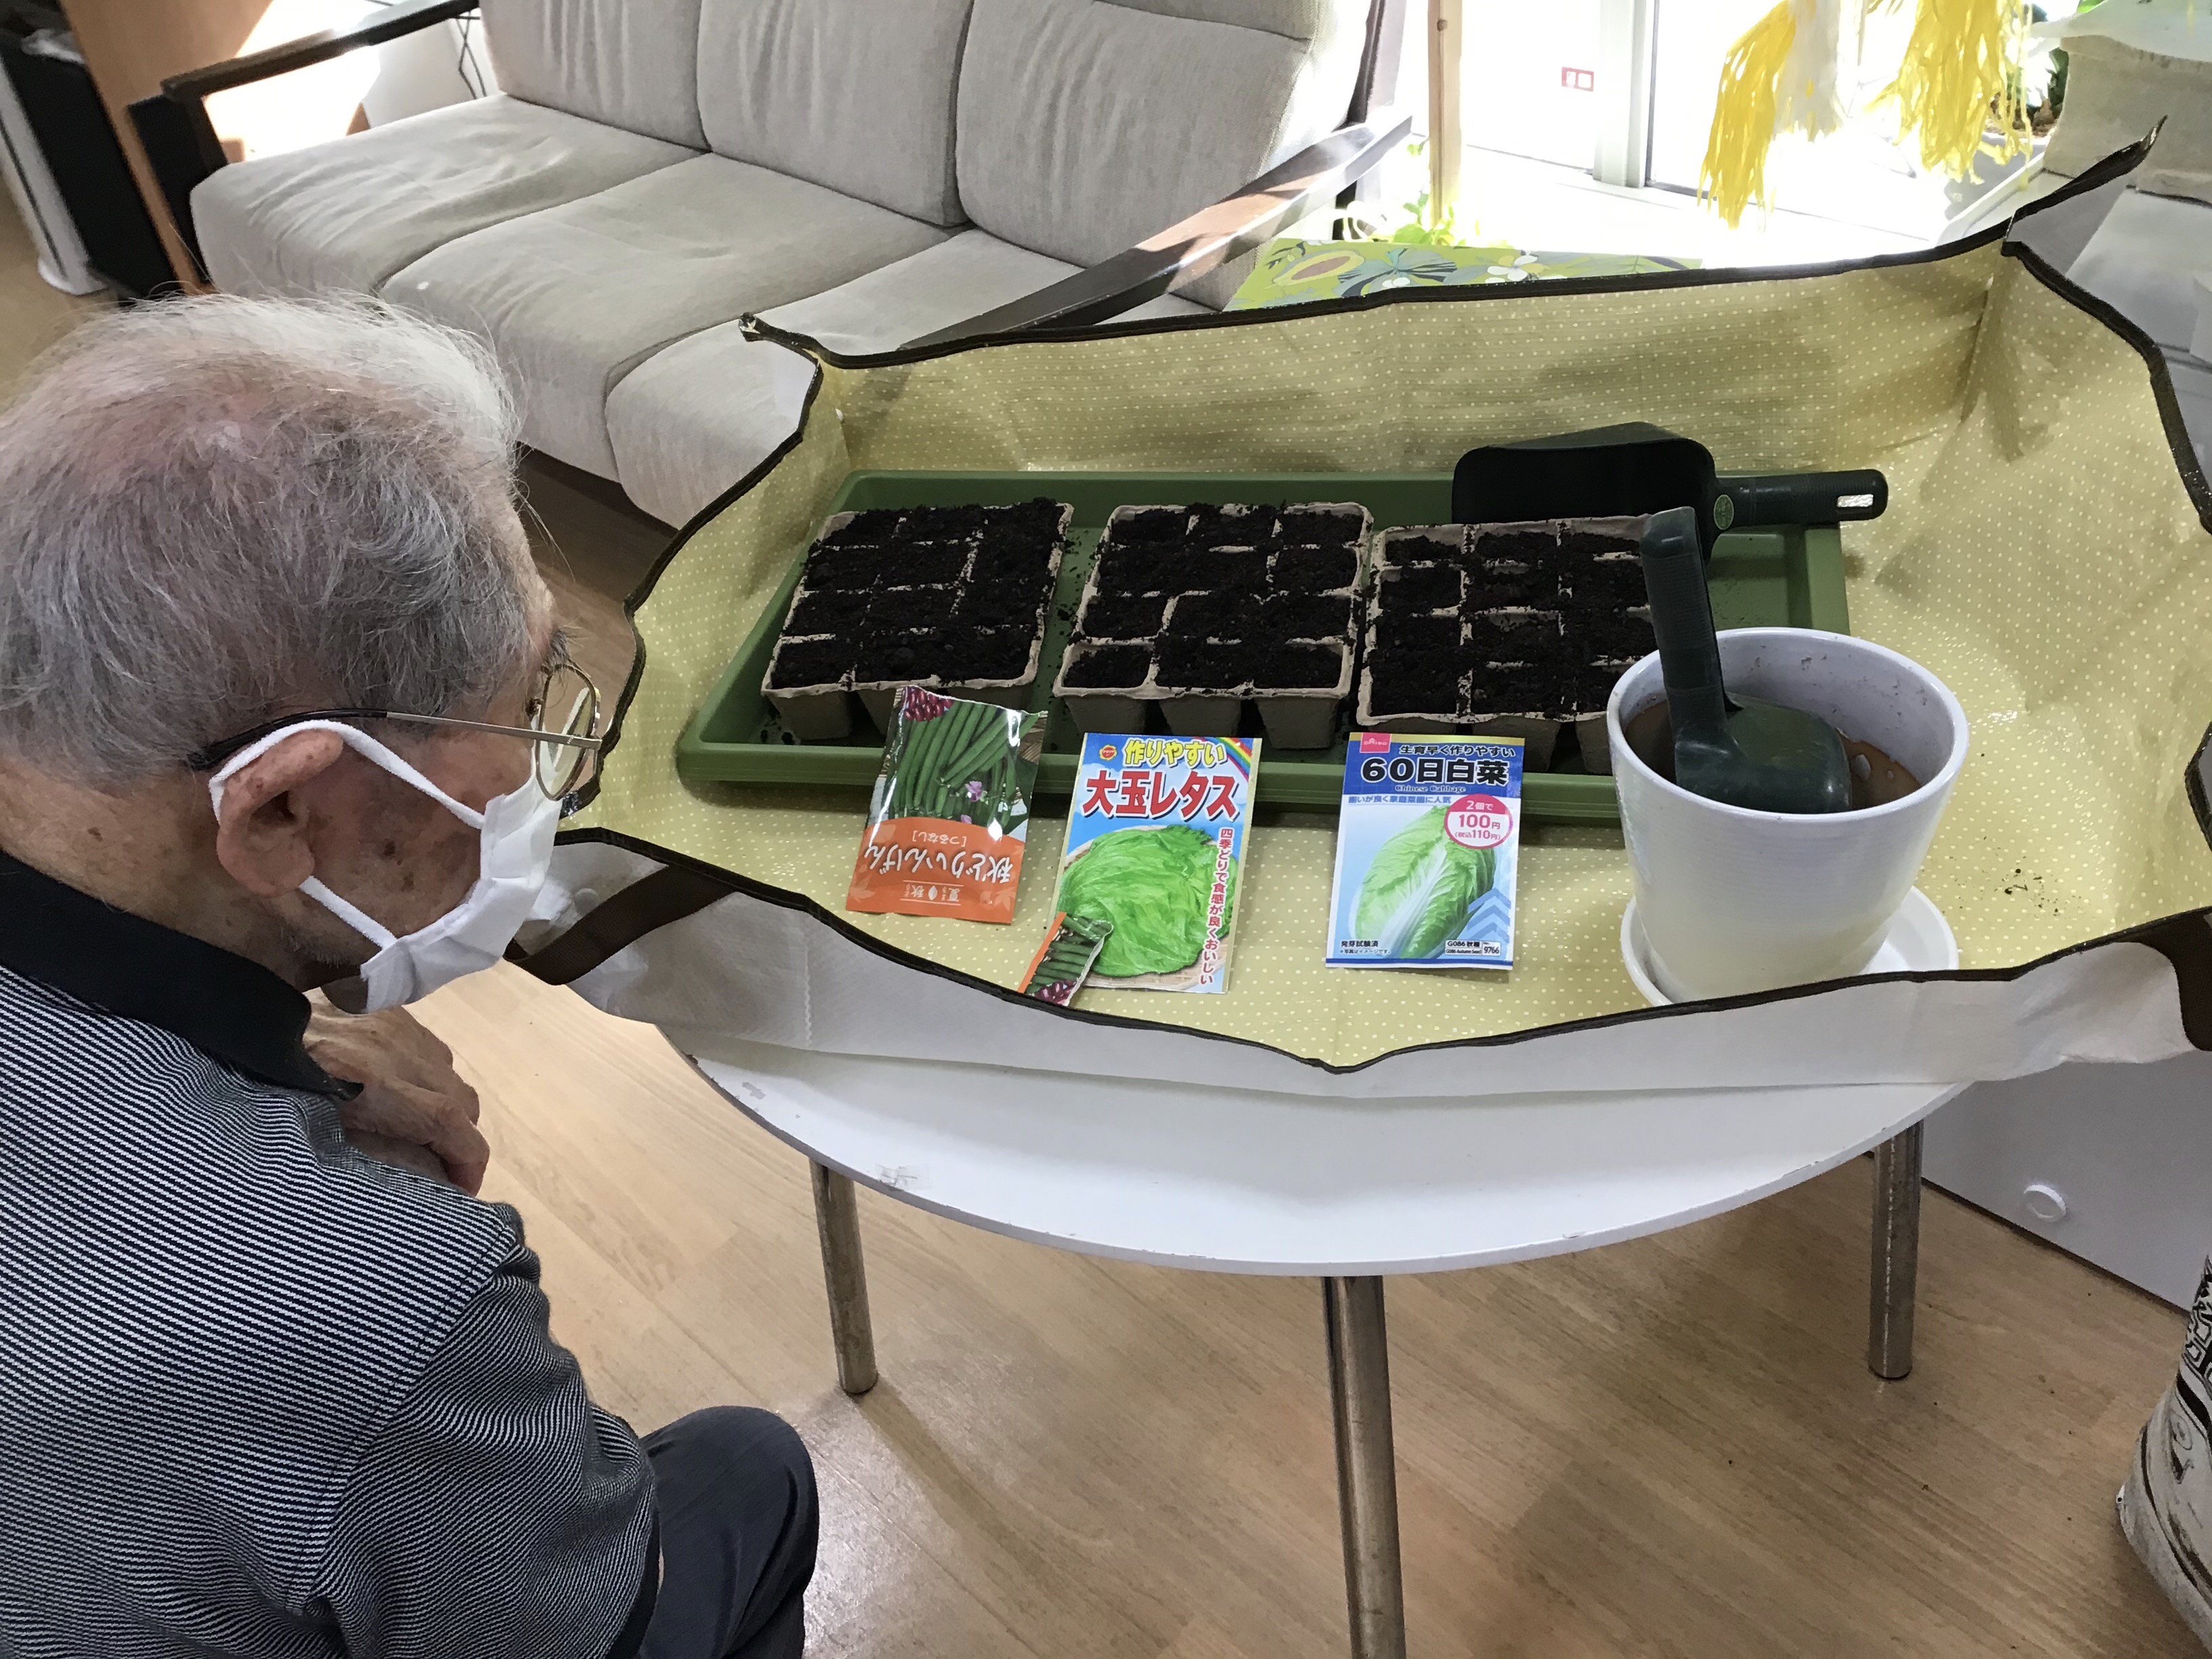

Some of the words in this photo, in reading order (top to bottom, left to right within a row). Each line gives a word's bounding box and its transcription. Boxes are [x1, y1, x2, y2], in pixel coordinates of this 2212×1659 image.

[1124, 739, 1225, 766] 作りやすい
[1399, 745, 1515, 758] 生育早く作りやすい
[1361, 758, 1509, 785] 60日白菜
[1082, 770, 1237, 819] 大玉レタス
[1466, 800, 1494, 811] 2個で
[1459, 814, 1501, 830] 100円
[864, 844, 1014, 884] 秋どりいんげん
[1200, 828, 1233, 985] 四季どりで食感が良くおいしい
[1483, 946, 1500, 954] 9766
